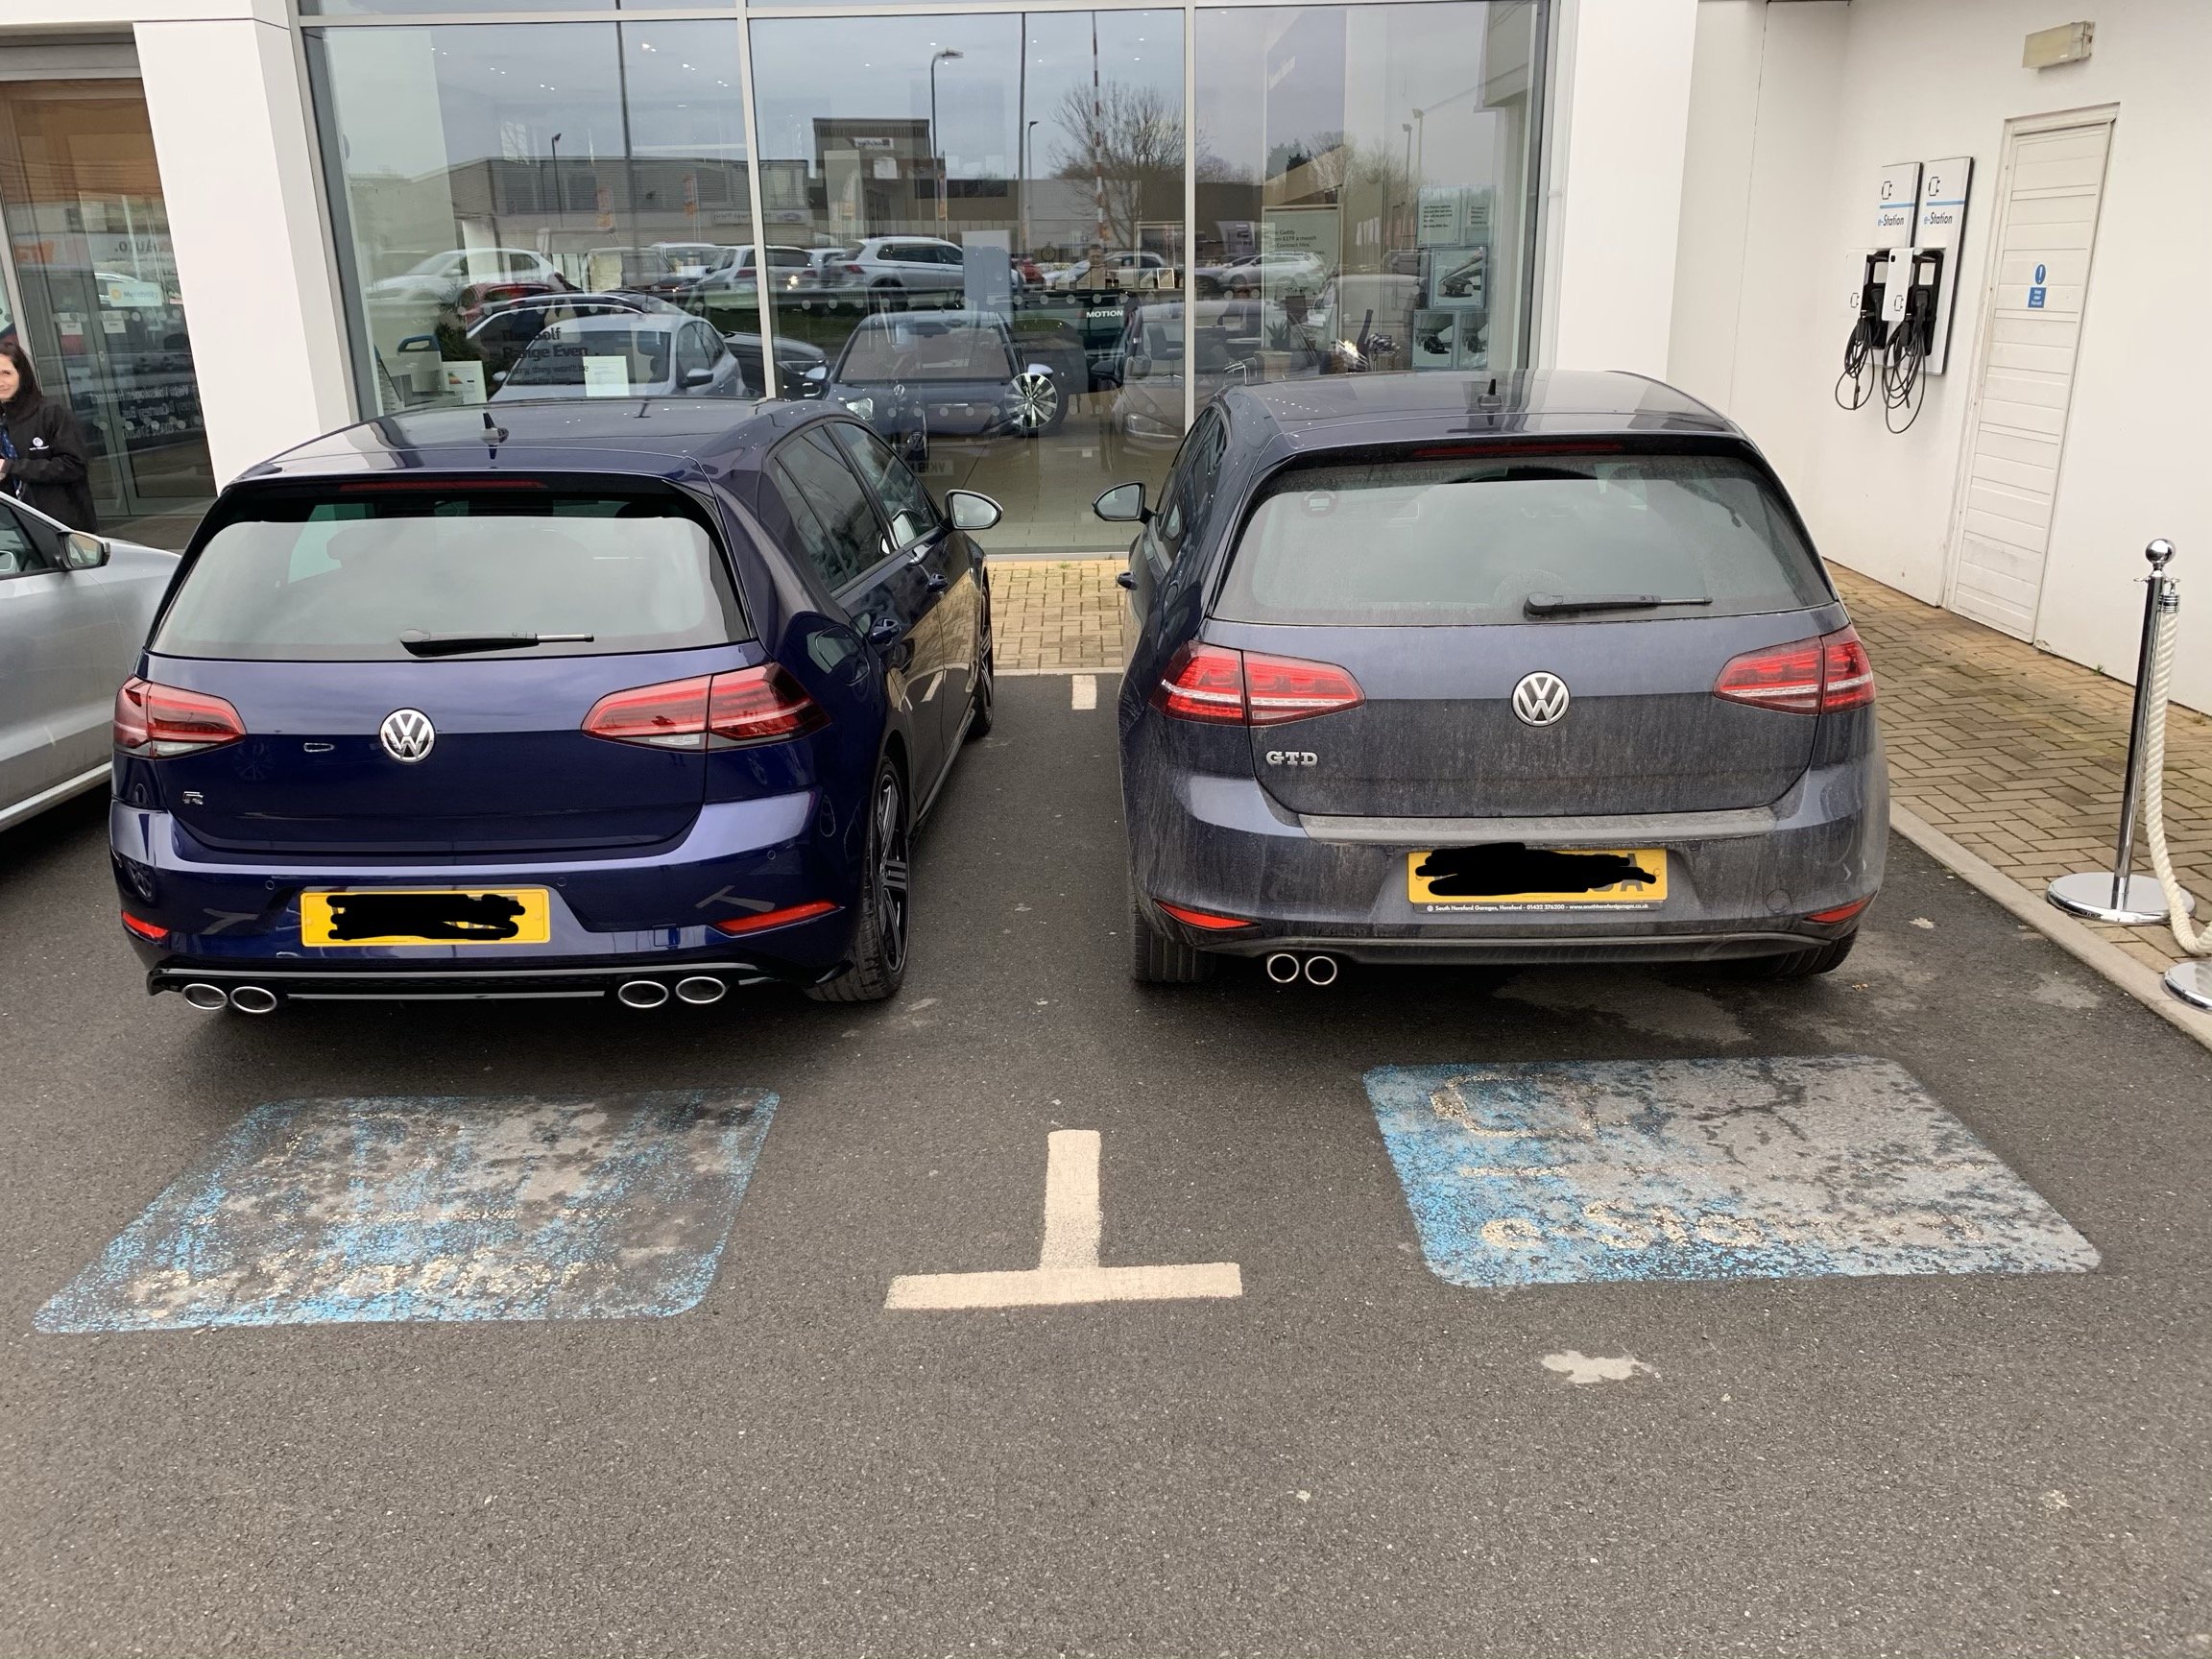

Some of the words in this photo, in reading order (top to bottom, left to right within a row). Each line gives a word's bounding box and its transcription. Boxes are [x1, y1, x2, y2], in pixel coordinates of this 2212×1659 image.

[1877, 214, 1905, 227] e-Station
[1923, 211, 1953, 225] e-Station
[1265, 751, 1318, 765] GTD
